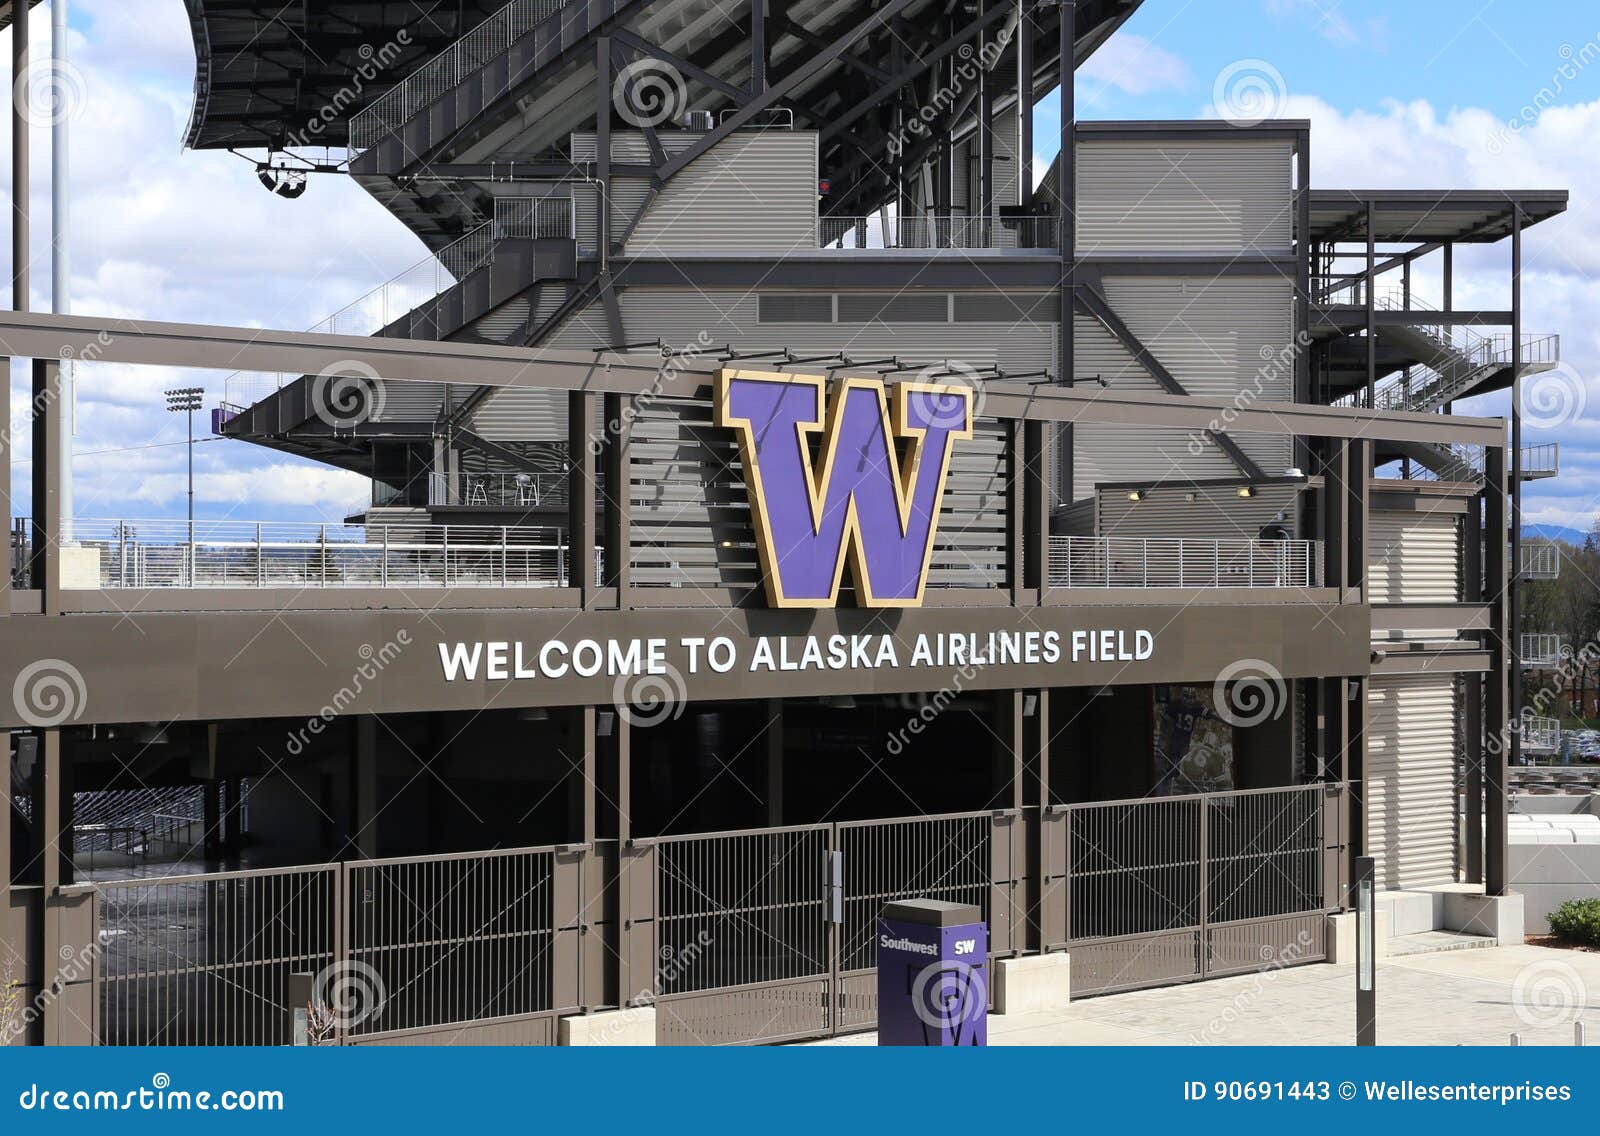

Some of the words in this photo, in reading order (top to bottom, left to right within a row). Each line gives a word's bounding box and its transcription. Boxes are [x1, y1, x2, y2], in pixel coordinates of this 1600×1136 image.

[713, 368, 973, 608] W
[438, 639, 667, 681] WELCOME
[680, 636, 736, 673] TO
[749, 634, 899, 672] ALASKA
[910, 630, 1061, 667] AIRLINES
[1071, 629, 1154, 662] FIELD
[880, 934, 939, 956] Southwest
[954, 939, 976, 955] SW
